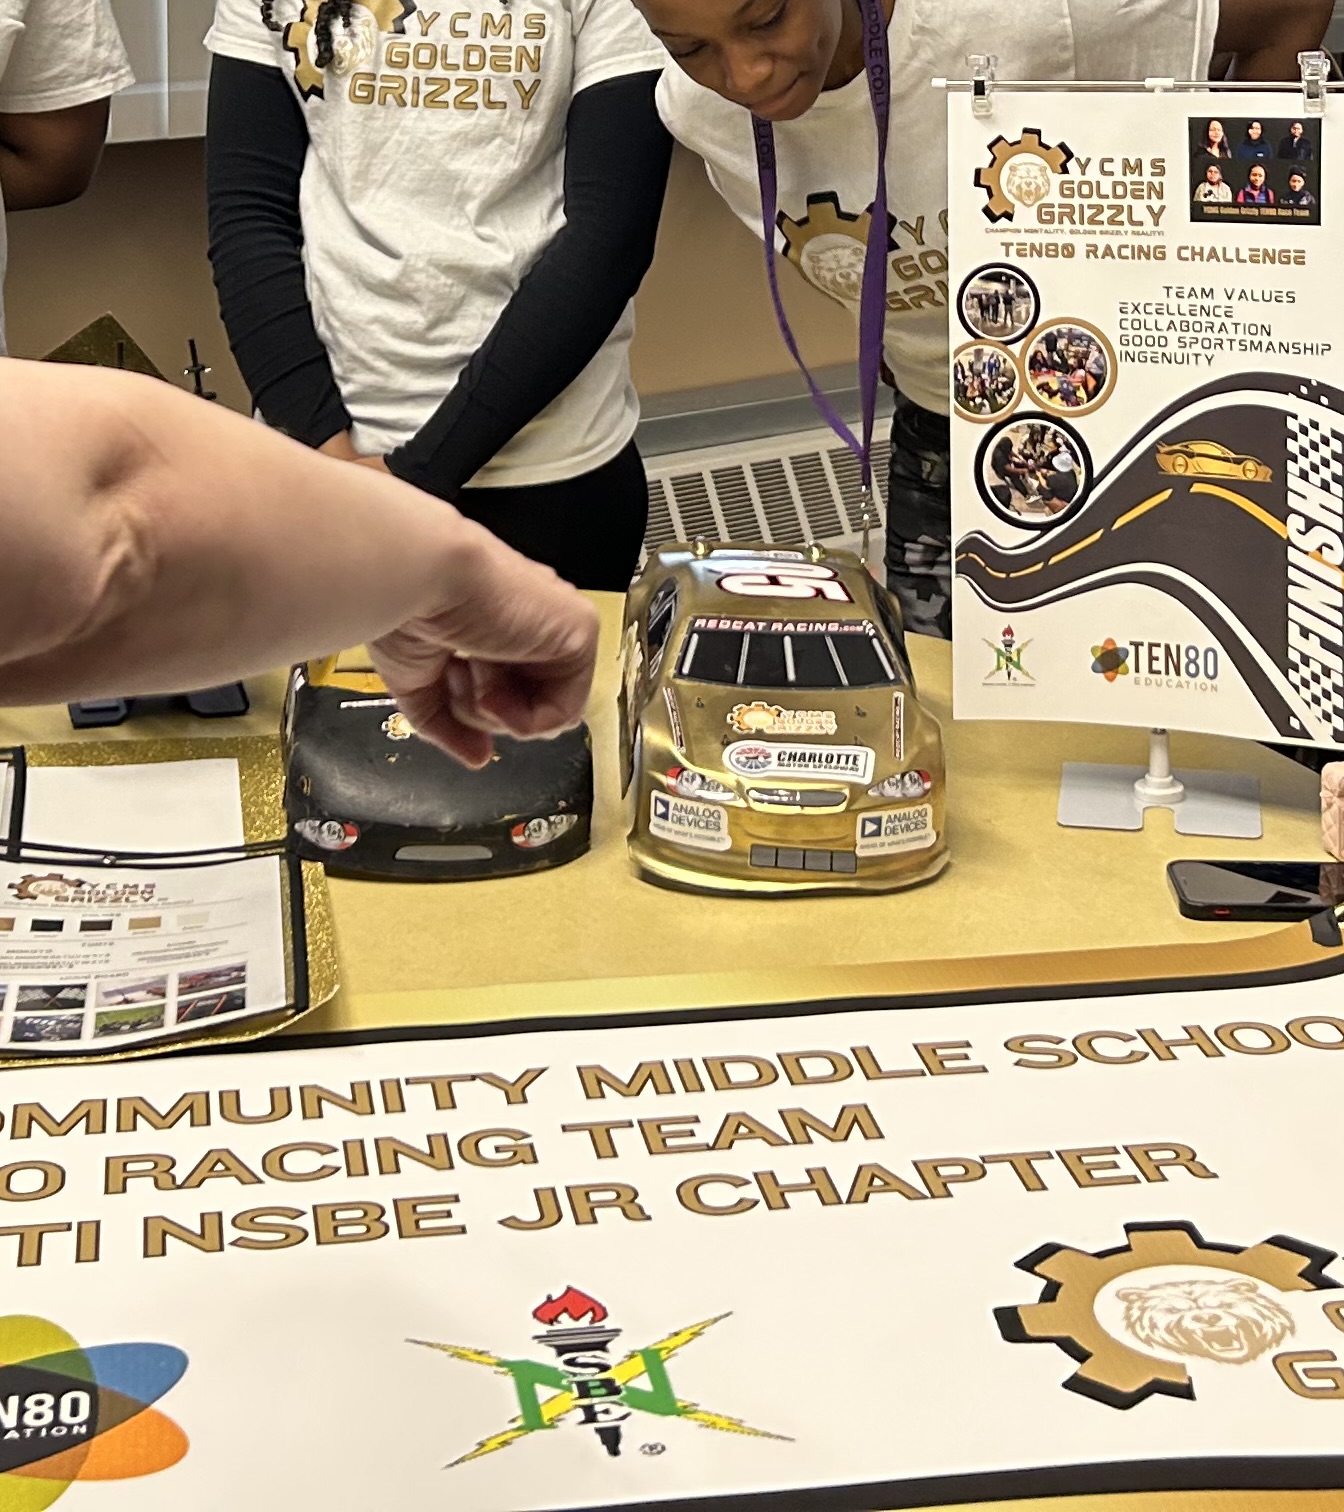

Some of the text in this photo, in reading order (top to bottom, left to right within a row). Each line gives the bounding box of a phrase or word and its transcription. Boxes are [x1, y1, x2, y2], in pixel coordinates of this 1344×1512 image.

[416, 10, 546, 40] YCMS
[385, 41, 541, 73] GOLDEN
[349, 72, 542, 110] GRIZZLY
[1075, 157, 1166, 176] YCMS
[1059, 180, 1164, 200] GOLDEN
[1037, 203, 1166, 227] GRIZZLY
[1000, 242, 1307, 266] TEN80 RACING CHALLENGE
[1162, 286, 1296, 303] TEAM VALUES
[1119, 302, 1234, 318] EXCELLENCE
[1119, 318, 1272, 337] COLLABORATION
[1119, 334, 1332, 356] GOOD SPORTSMANSHIP
[1119, 351, 1215, 366] INGENUITY
[1287, 472, 1344, 673] FINISH
[694, 618, 767, 632] REDCAT
[1129, 640, 1219, 680] TEN80
[1133, 676, 1218, 693] EDUCATION
[777, 750, 860, 767] CHARLOTTE
[672, 802, 722, 821] ANALOG
[886, 807, 928, 824] ANALOG
[671, 813, 722, 832] DEVICES
[884, 818, 928, 836] DEVICES
[575, 1038, 989, 1101] MIDDLE
[103, 1127, 539, 1197] RACING
[561, 1102, 888, 1161] TEAM
[141, 1192, 468, 1259] NSBE
[497, 1180, 653, 1234] JR
[675, 1139, 1220, 1219] CHAPTER
